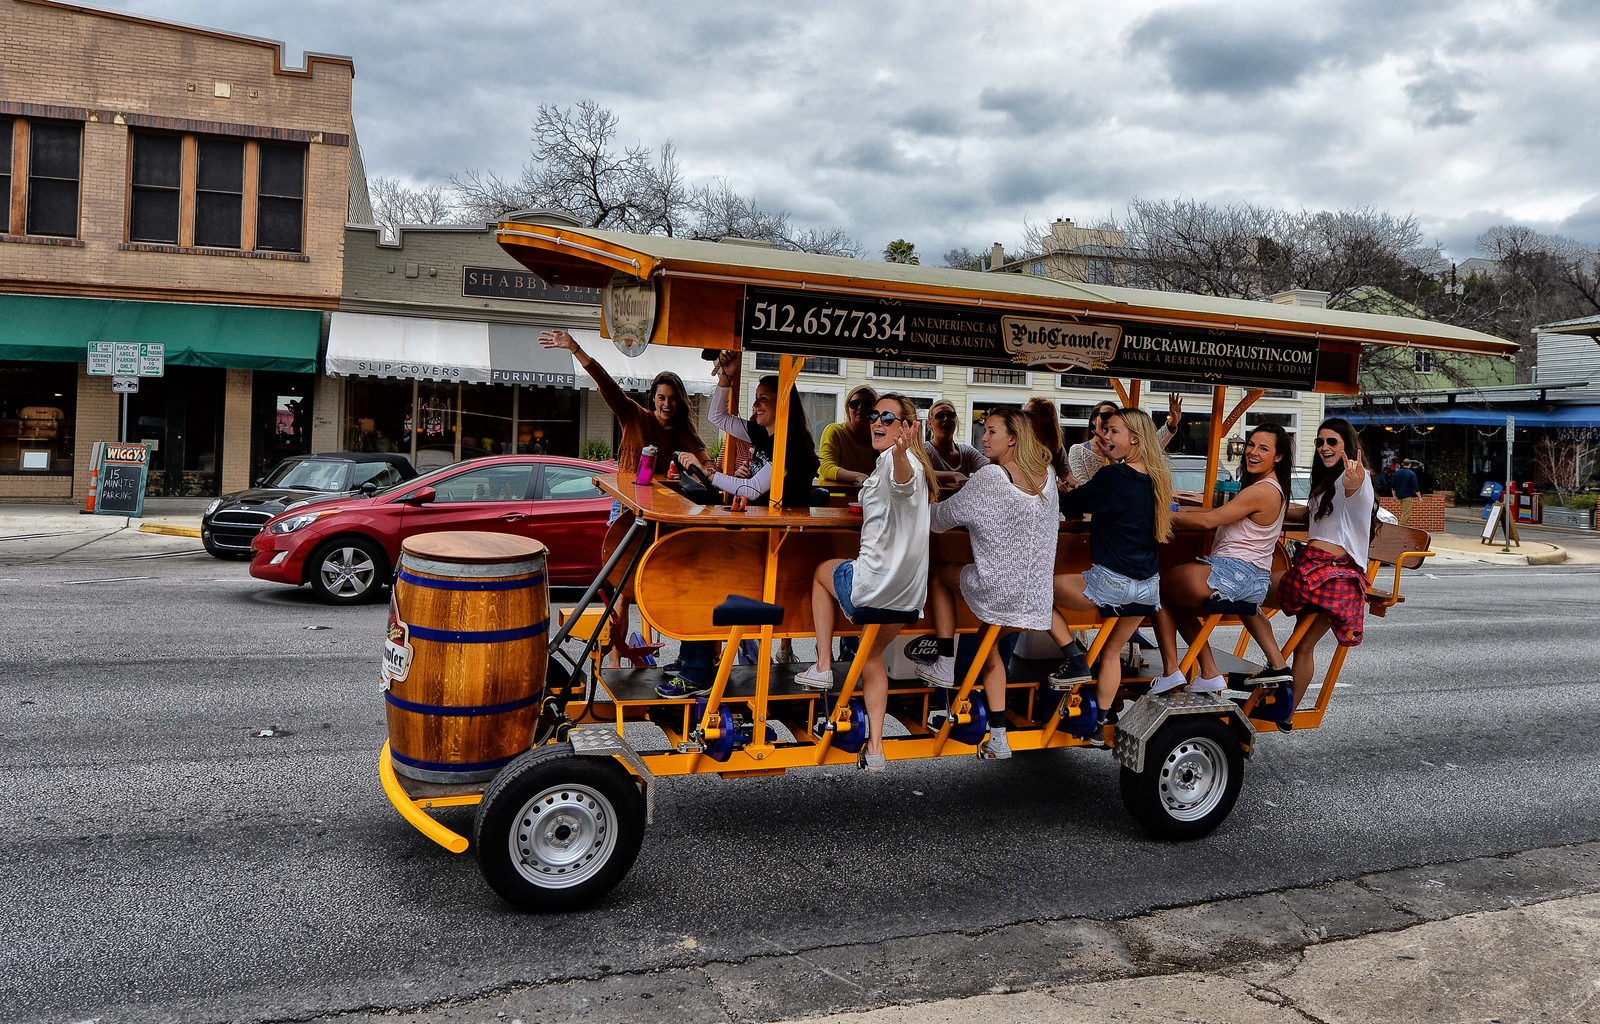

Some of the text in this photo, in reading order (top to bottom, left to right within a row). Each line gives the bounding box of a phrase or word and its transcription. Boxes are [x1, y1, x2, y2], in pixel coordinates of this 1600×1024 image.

[469, 272, 549, 291] SHABBY
[488, 288, 597, 302] INTERIORS
[751, 301, 906, 341] 512.657.7334
[911, 316, 997, 334] AN EXPERIENCE AS
[911, 332, 996, 349] UNIQUE AS AUSTIN
[1009, 323, 1113, 350] PubCrawler
[141, 345, 147, 354] 2
[1123, 334, 1313, 364] PUBCRAWLEROFAUSTIN.COM
[358, 362, 460, 377] SLIP COVERS
[1122, 351, 1311, 375] MAKE A RESERVATION ONLINE TODAY!
[493, 371, 575, 385] FURNITURE
[107, 447, 147, 461] WIGGY'S
[110, 468, 120, 479] 15
[104, 478, 134, 490] MINUTE
[102, 490, 133, 500] PARKING
[918, 639, 938, 648] BU
[911, 647, 938, 655] LIGH
